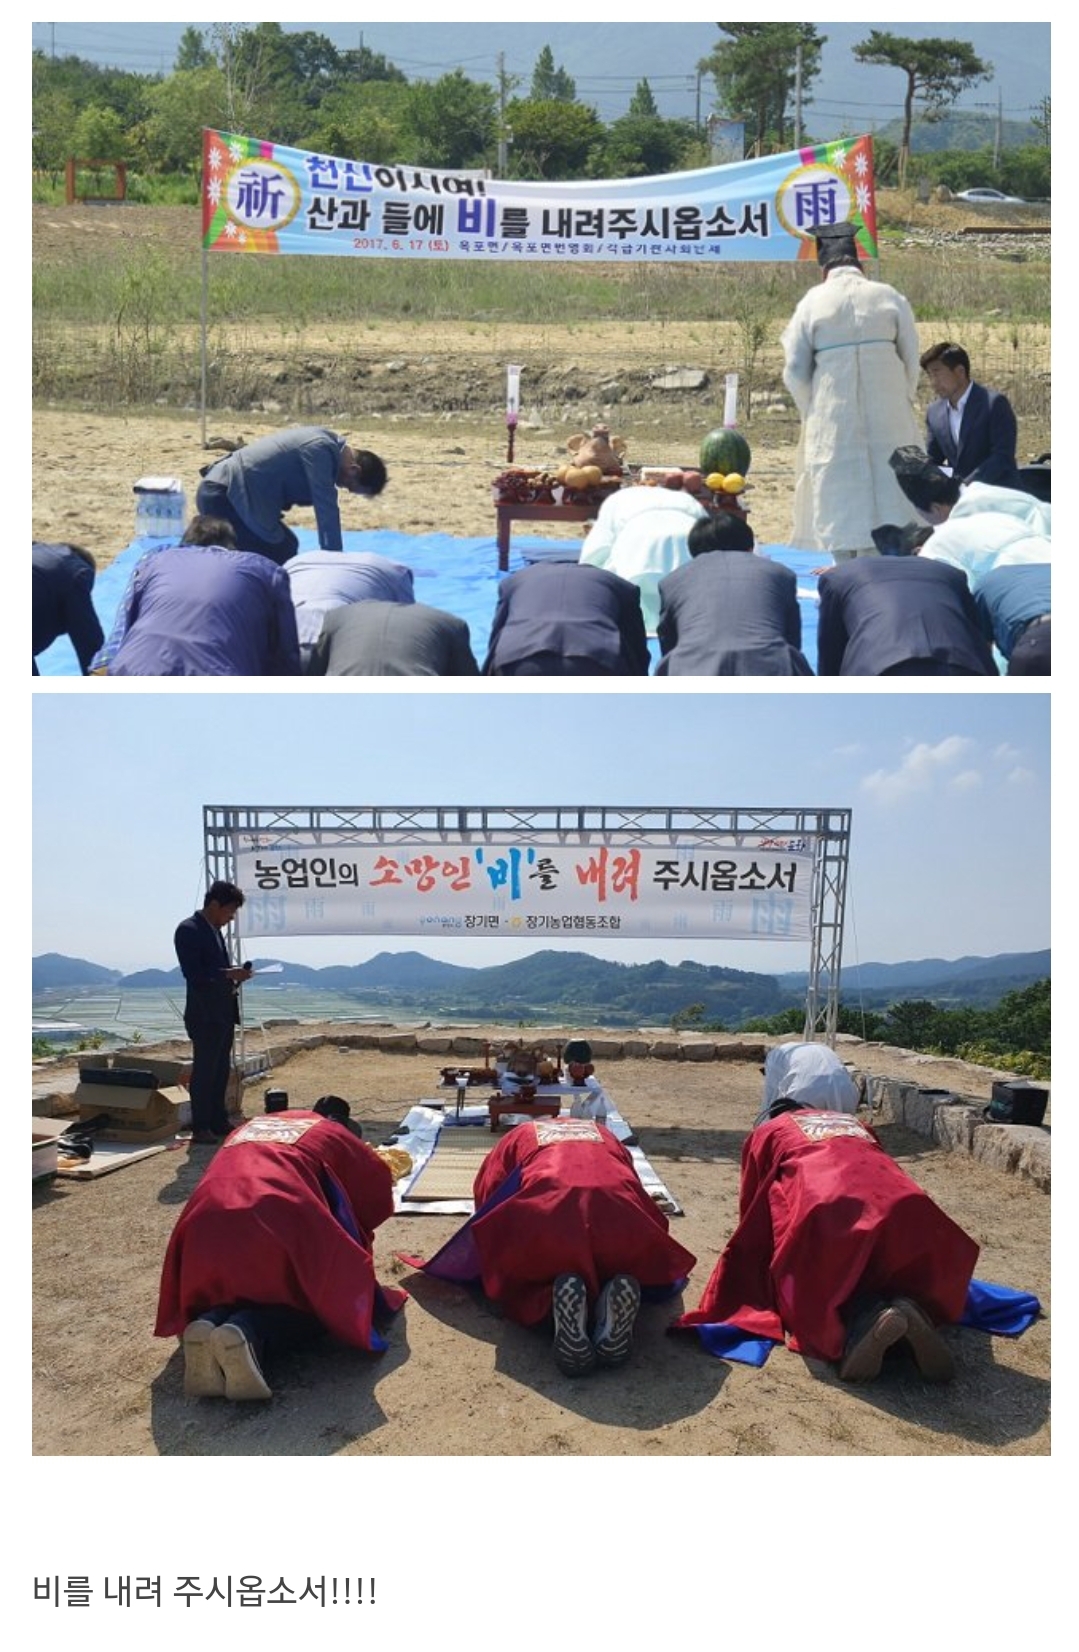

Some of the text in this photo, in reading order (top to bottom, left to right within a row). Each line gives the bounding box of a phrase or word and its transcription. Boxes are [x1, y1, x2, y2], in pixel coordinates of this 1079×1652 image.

[236, 171, 285, 219] 祈
[306, 155, 487, 198] 천신이시여!
[306, 197, 769, 239] 산과 들에 비를 내려주시옵소서
[793, 178, 838, 226] 雨
[353, 238, 449, 251] 2017. 6. 17 (토)
[254, 857, 359, 890] 농업인의
[368, 854, 471, 893] 소망인
[575, 846, 642, 902] 내려
[652, 860, 798, 893] 주시옵소서
[464, 915, 500, 929] 장기면
[525, 915, 622, 930] 장기농업협동조합
